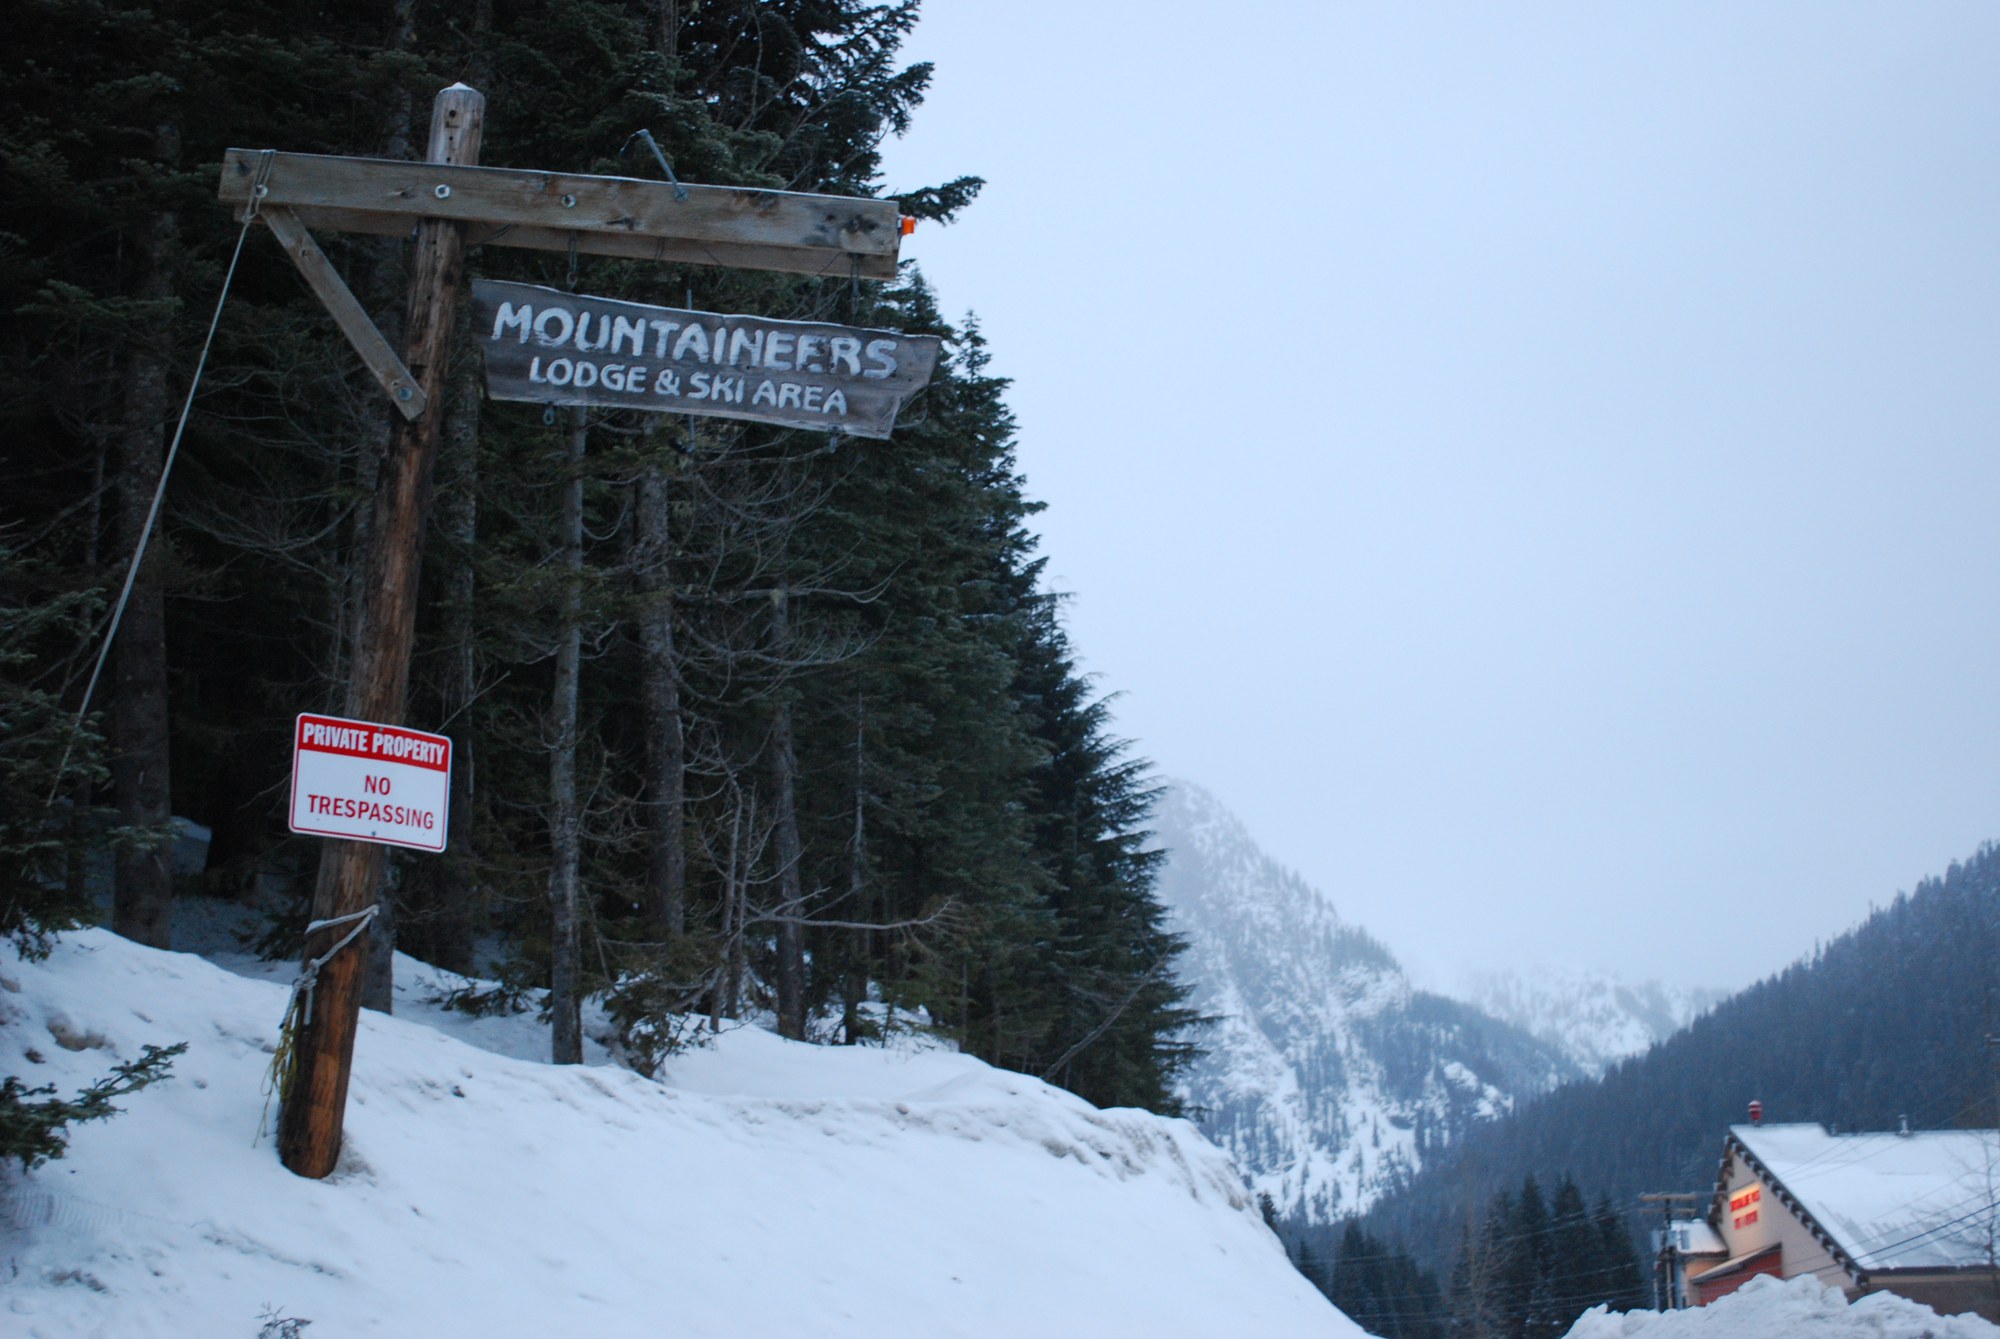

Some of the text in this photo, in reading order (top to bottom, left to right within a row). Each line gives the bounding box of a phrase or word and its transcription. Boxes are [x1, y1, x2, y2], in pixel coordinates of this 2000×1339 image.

[490, 301, 898, 379] MOUNTAINEERS
[529, 356, 848, 416] LODGE & SKI AREA
[302, 722, 446, 766] PRIVATE PROPERTY
[364, 775, 391, 795] NO
[308, 794, 434, 830] TRESPASSING
